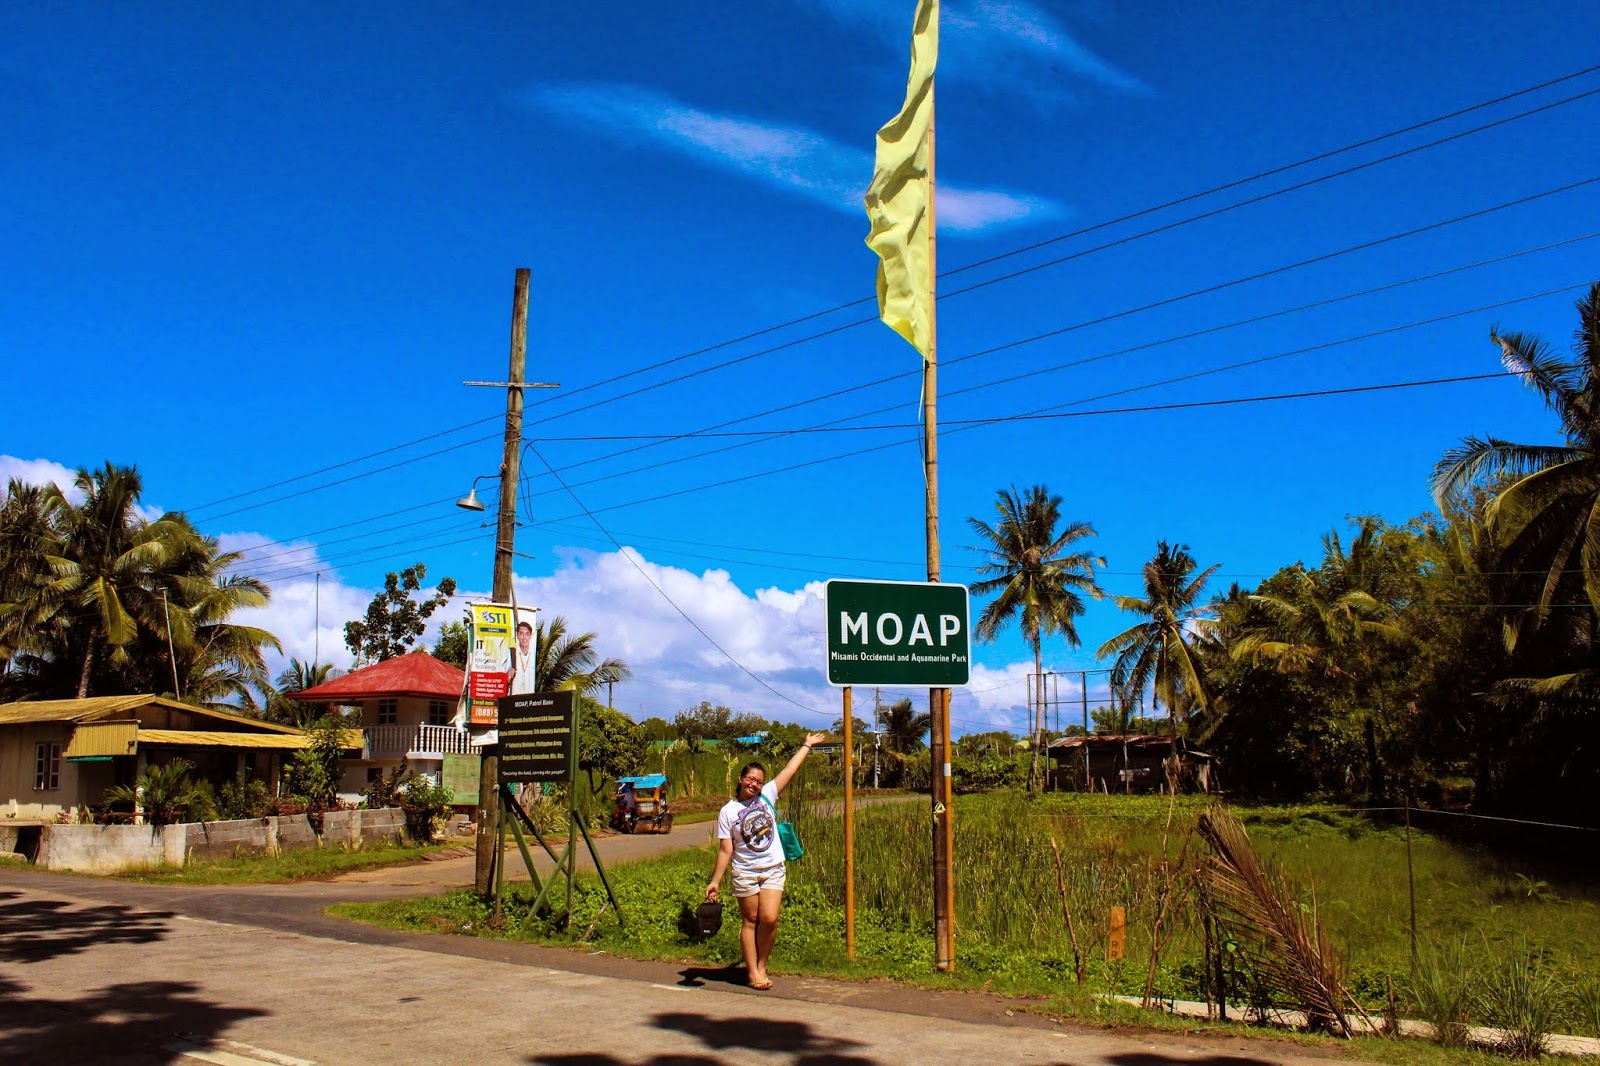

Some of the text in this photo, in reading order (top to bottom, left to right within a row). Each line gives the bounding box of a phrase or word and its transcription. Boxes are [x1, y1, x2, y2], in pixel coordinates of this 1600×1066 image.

[488, 612, 507, 625] STI
[840, 611, 961, 647] MOAP
[476, 640, 484, 650] IT
[831, 651, 967, 664] Misamis Occidental and Aquamarine Park
[475, 707, 493, 718] (088)
